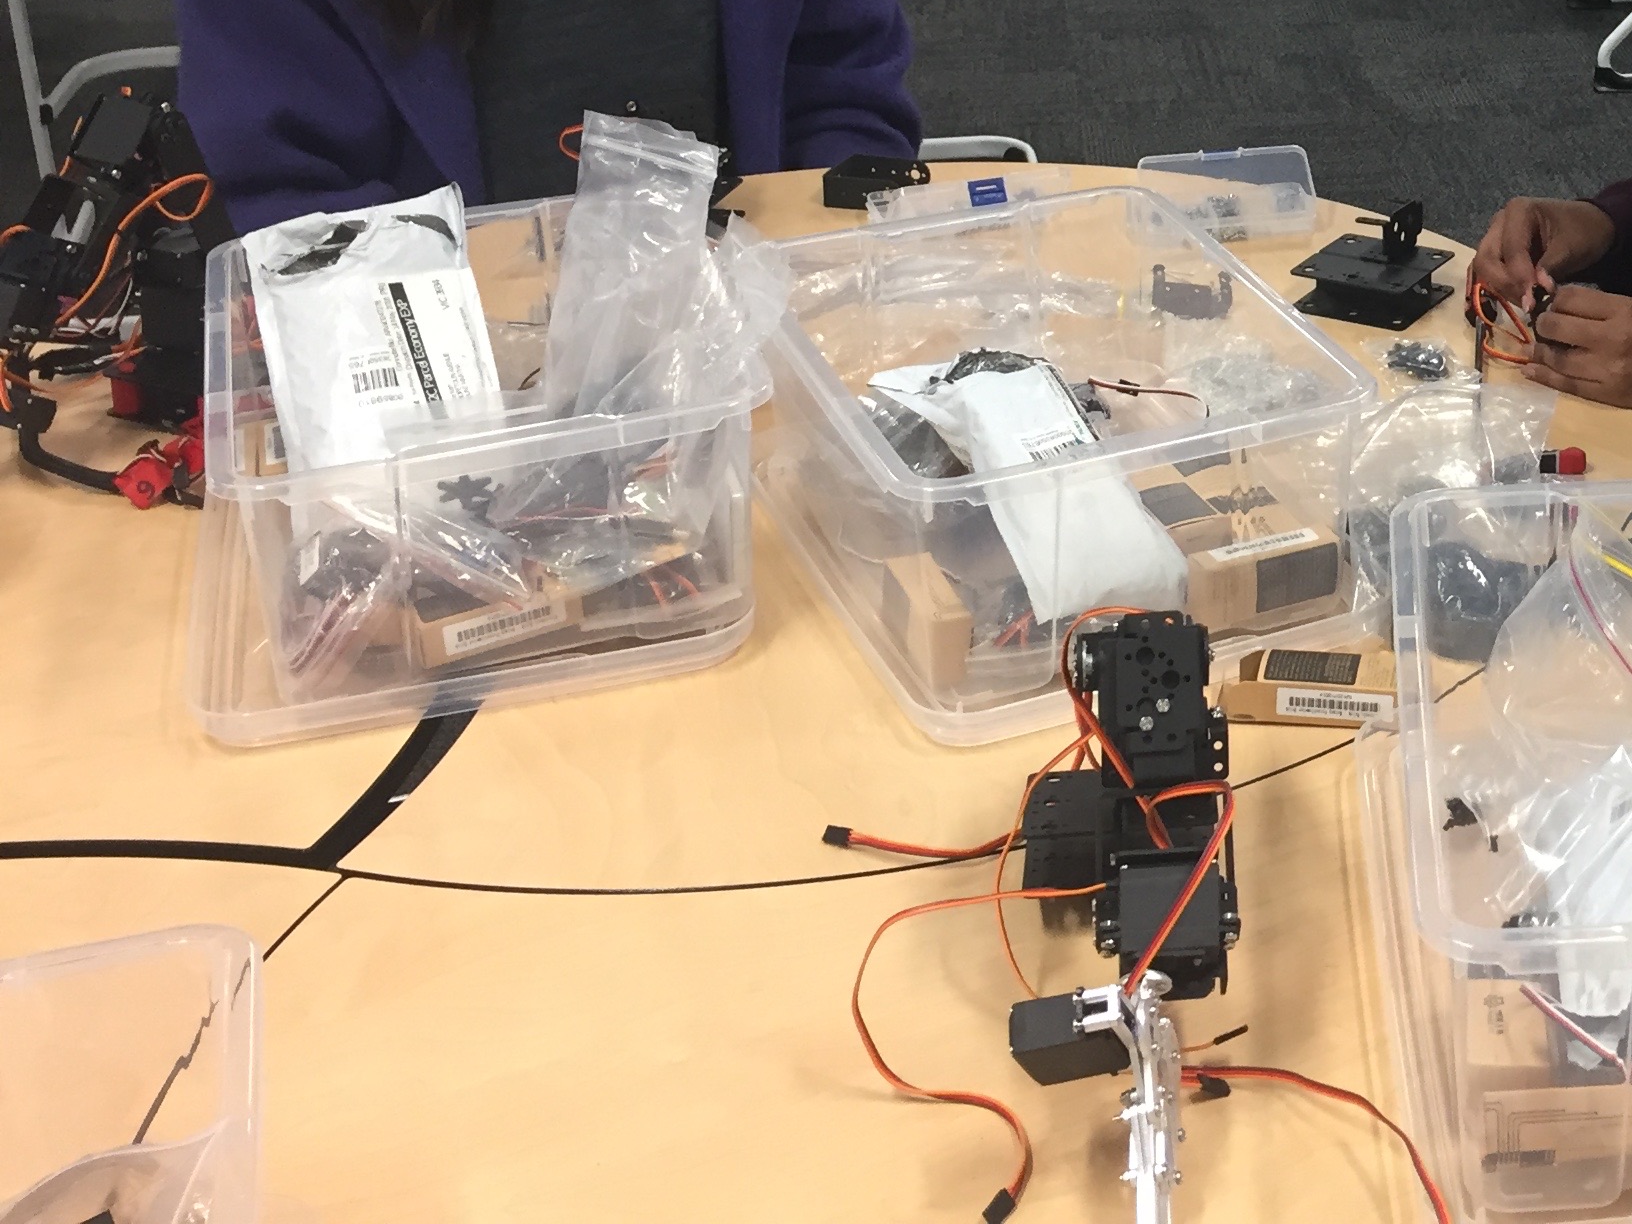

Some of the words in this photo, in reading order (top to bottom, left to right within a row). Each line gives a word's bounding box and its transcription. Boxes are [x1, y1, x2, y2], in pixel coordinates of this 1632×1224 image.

[396, 298, 411, 317] EXP
[405, 317, 425, 359] Economy
[416, 360, 434, 388] Parcel
